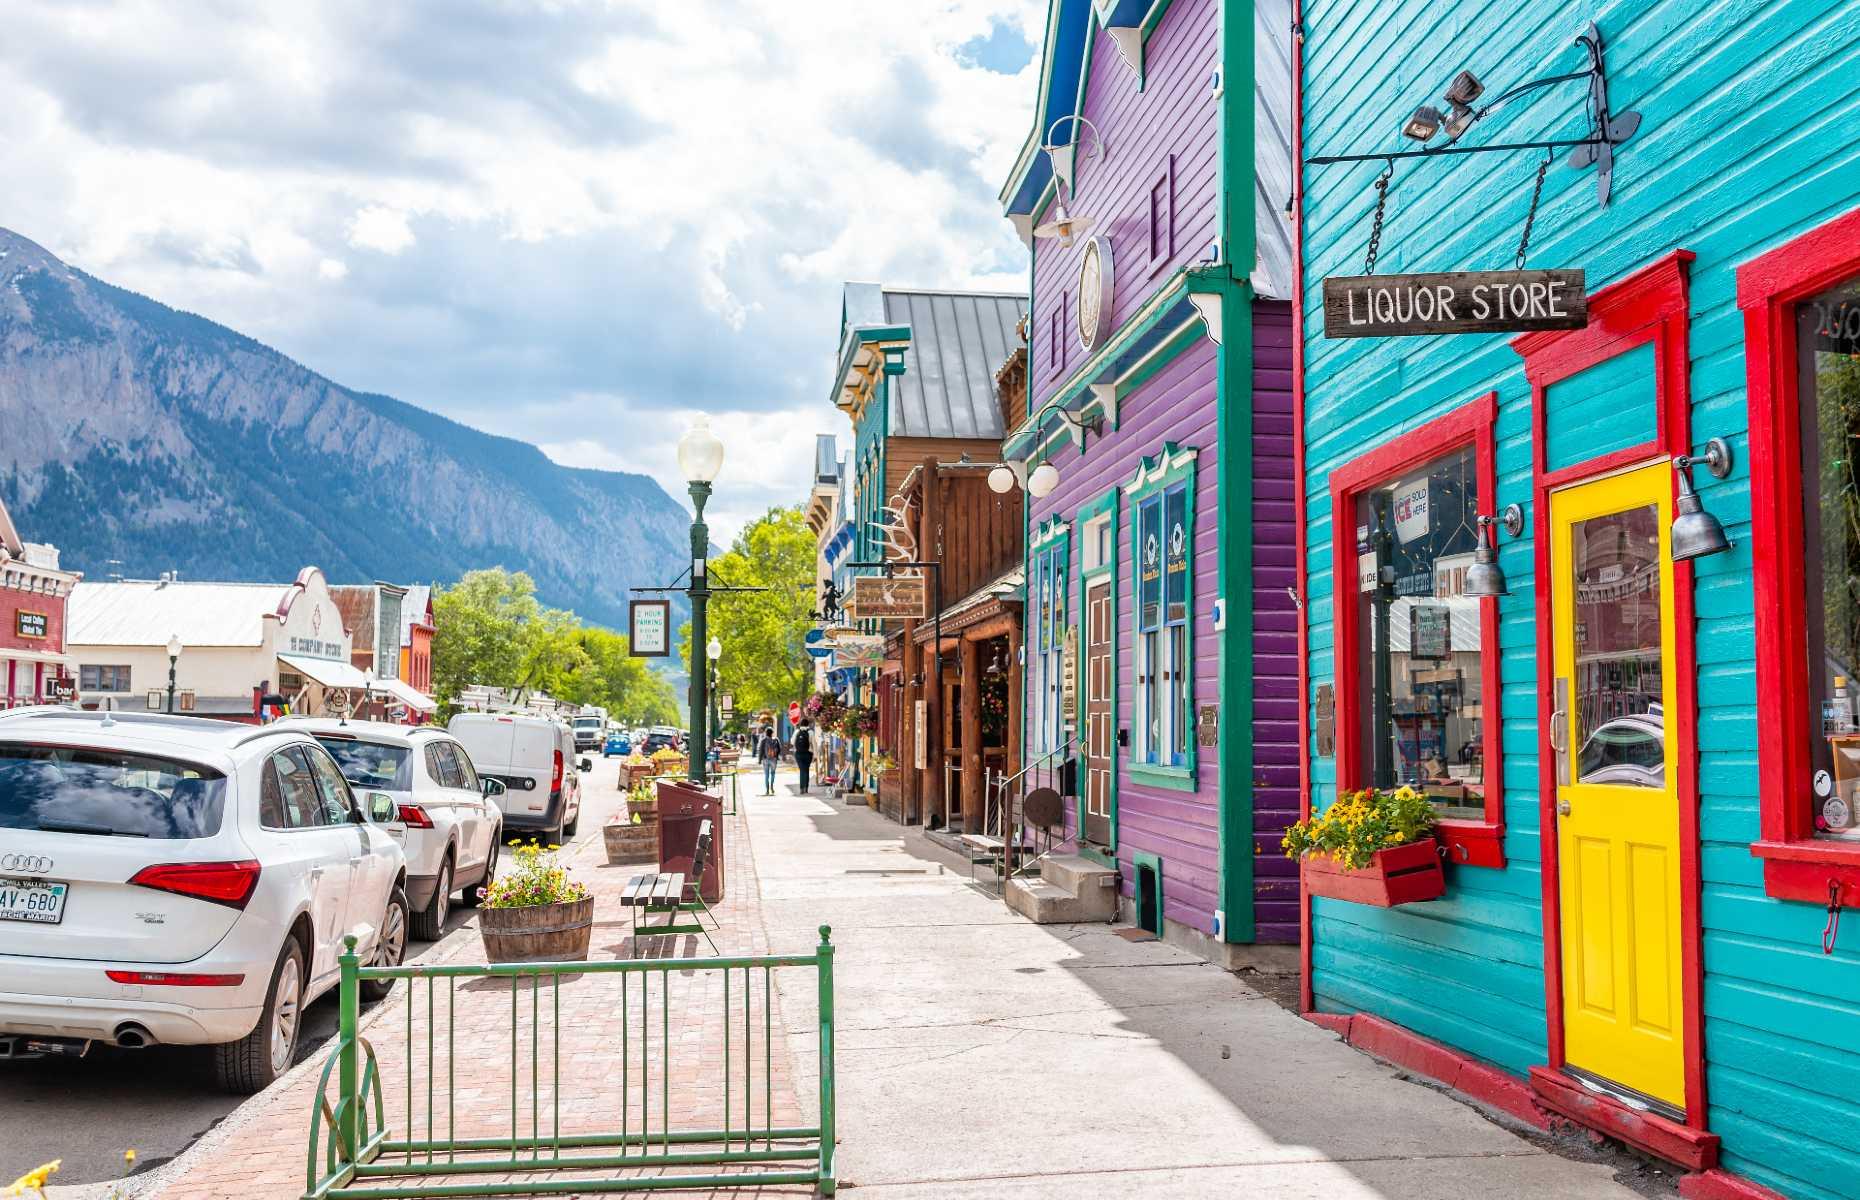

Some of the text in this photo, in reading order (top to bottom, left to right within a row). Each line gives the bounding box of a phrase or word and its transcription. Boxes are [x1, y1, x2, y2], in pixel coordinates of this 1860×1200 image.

[1348, 281, 1568, 326] LIQUOR STORE
[1411, 488, 1427, 502] SOLD
[1395, 497, 1412, 525] ICE
[1413, 503, 1427, 516] HERE
[644, 610, 661, 618] HOUR
[298, 638, 323, 654] COMPANY
